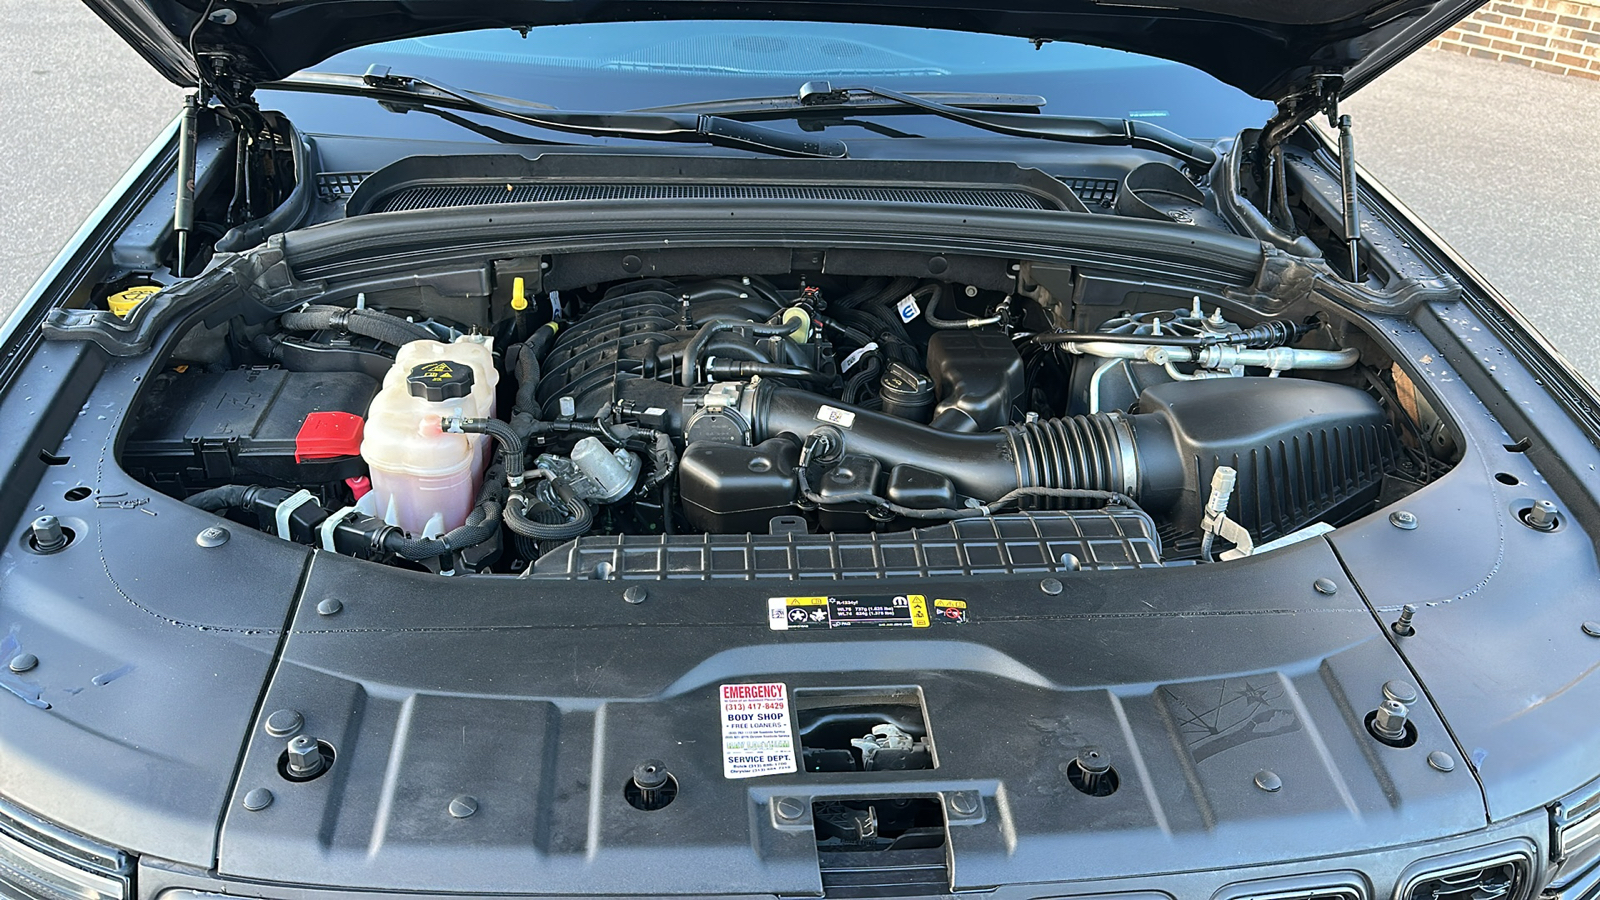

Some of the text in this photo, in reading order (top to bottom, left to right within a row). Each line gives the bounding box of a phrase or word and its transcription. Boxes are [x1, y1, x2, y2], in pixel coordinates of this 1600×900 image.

[724, 685, 783, 699] EMERGENCY
[725, 702, 784, 712] (313) 417-8429
[757, 713, 784, 721] SHOP
[728, 754, 791, 764] SERVICE DEPT.
